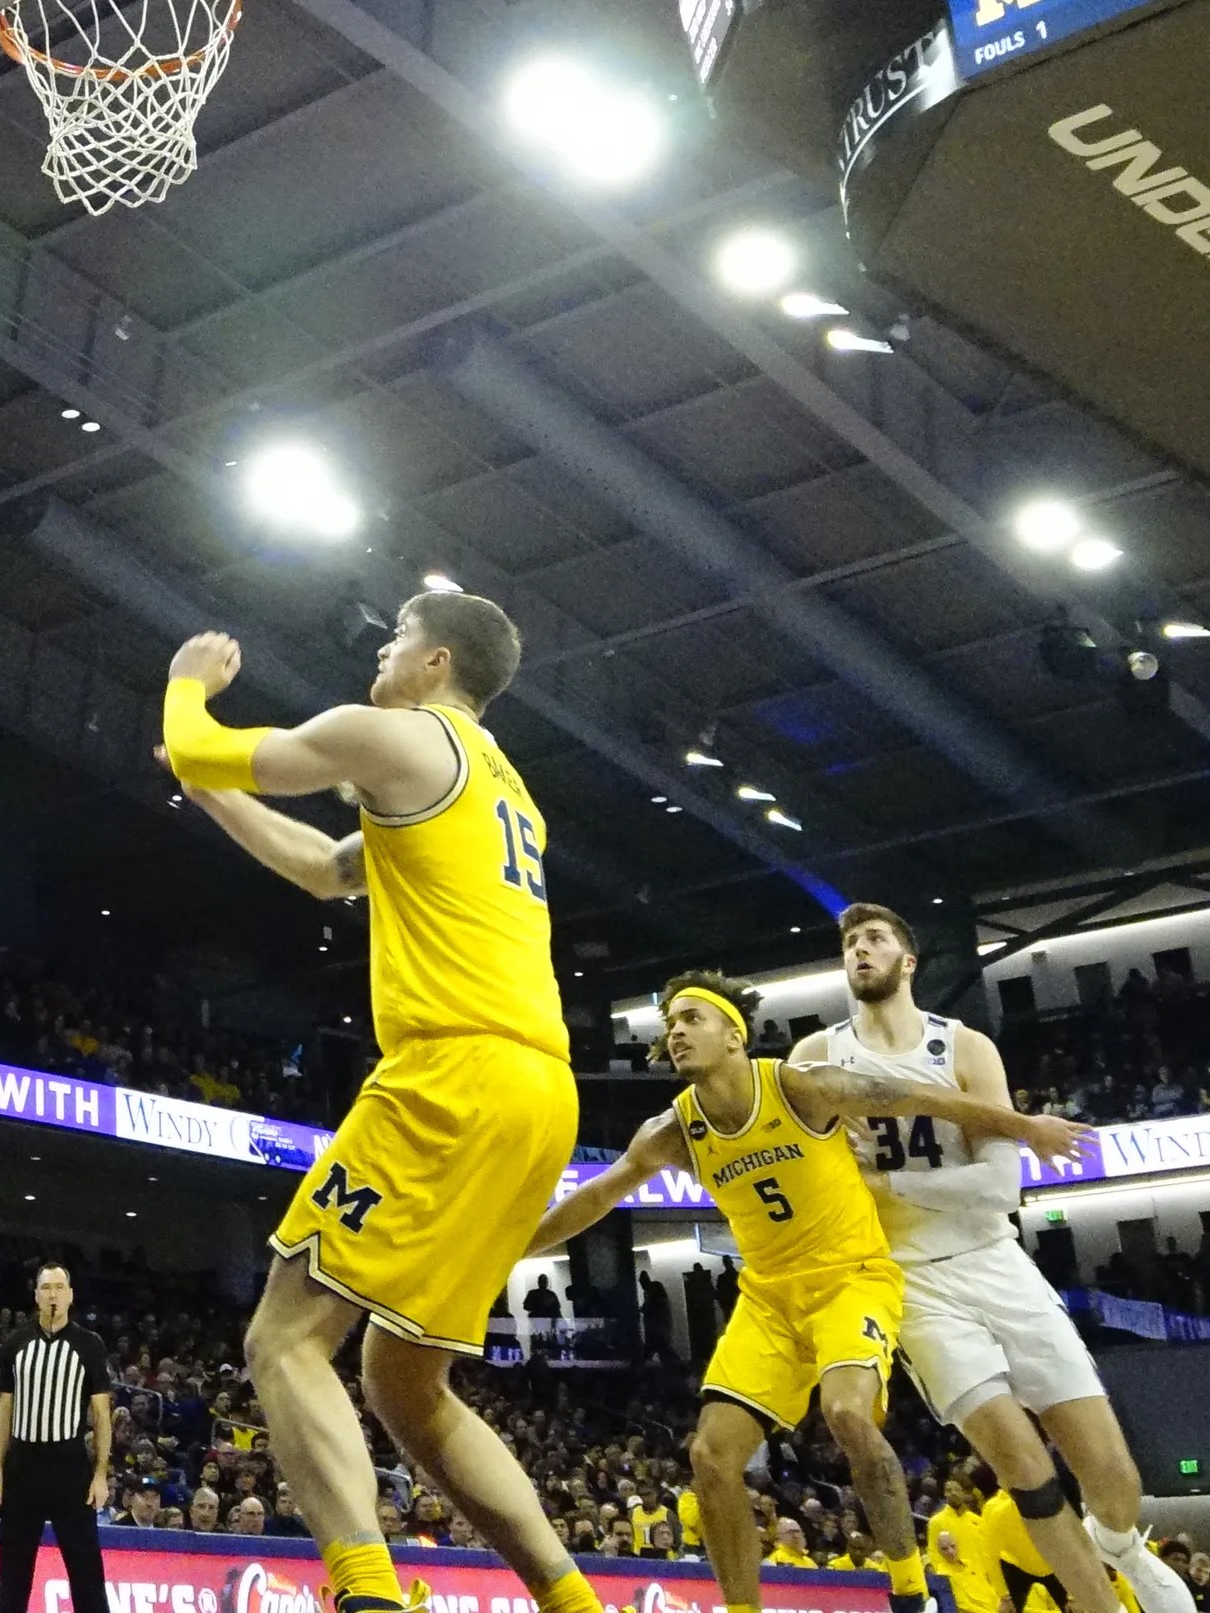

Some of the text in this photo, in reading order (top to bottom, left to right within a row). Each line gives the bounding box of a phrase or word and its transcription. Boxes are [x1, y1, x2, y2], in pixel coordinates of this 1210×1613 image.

[974, 20, 1048, 65] FOULS 1
[840, 32, 935, 160] TRUST
[496, 799, 547, 903] 15
[122, 1093, 218, 1147] WINDY
[867, 1115, 944, 1171] 34
[712, 1143, 804, 1189] MICHIGAN
[311, 1161, 383, 1234] M
[752, 1177, 794, 1223] 5
